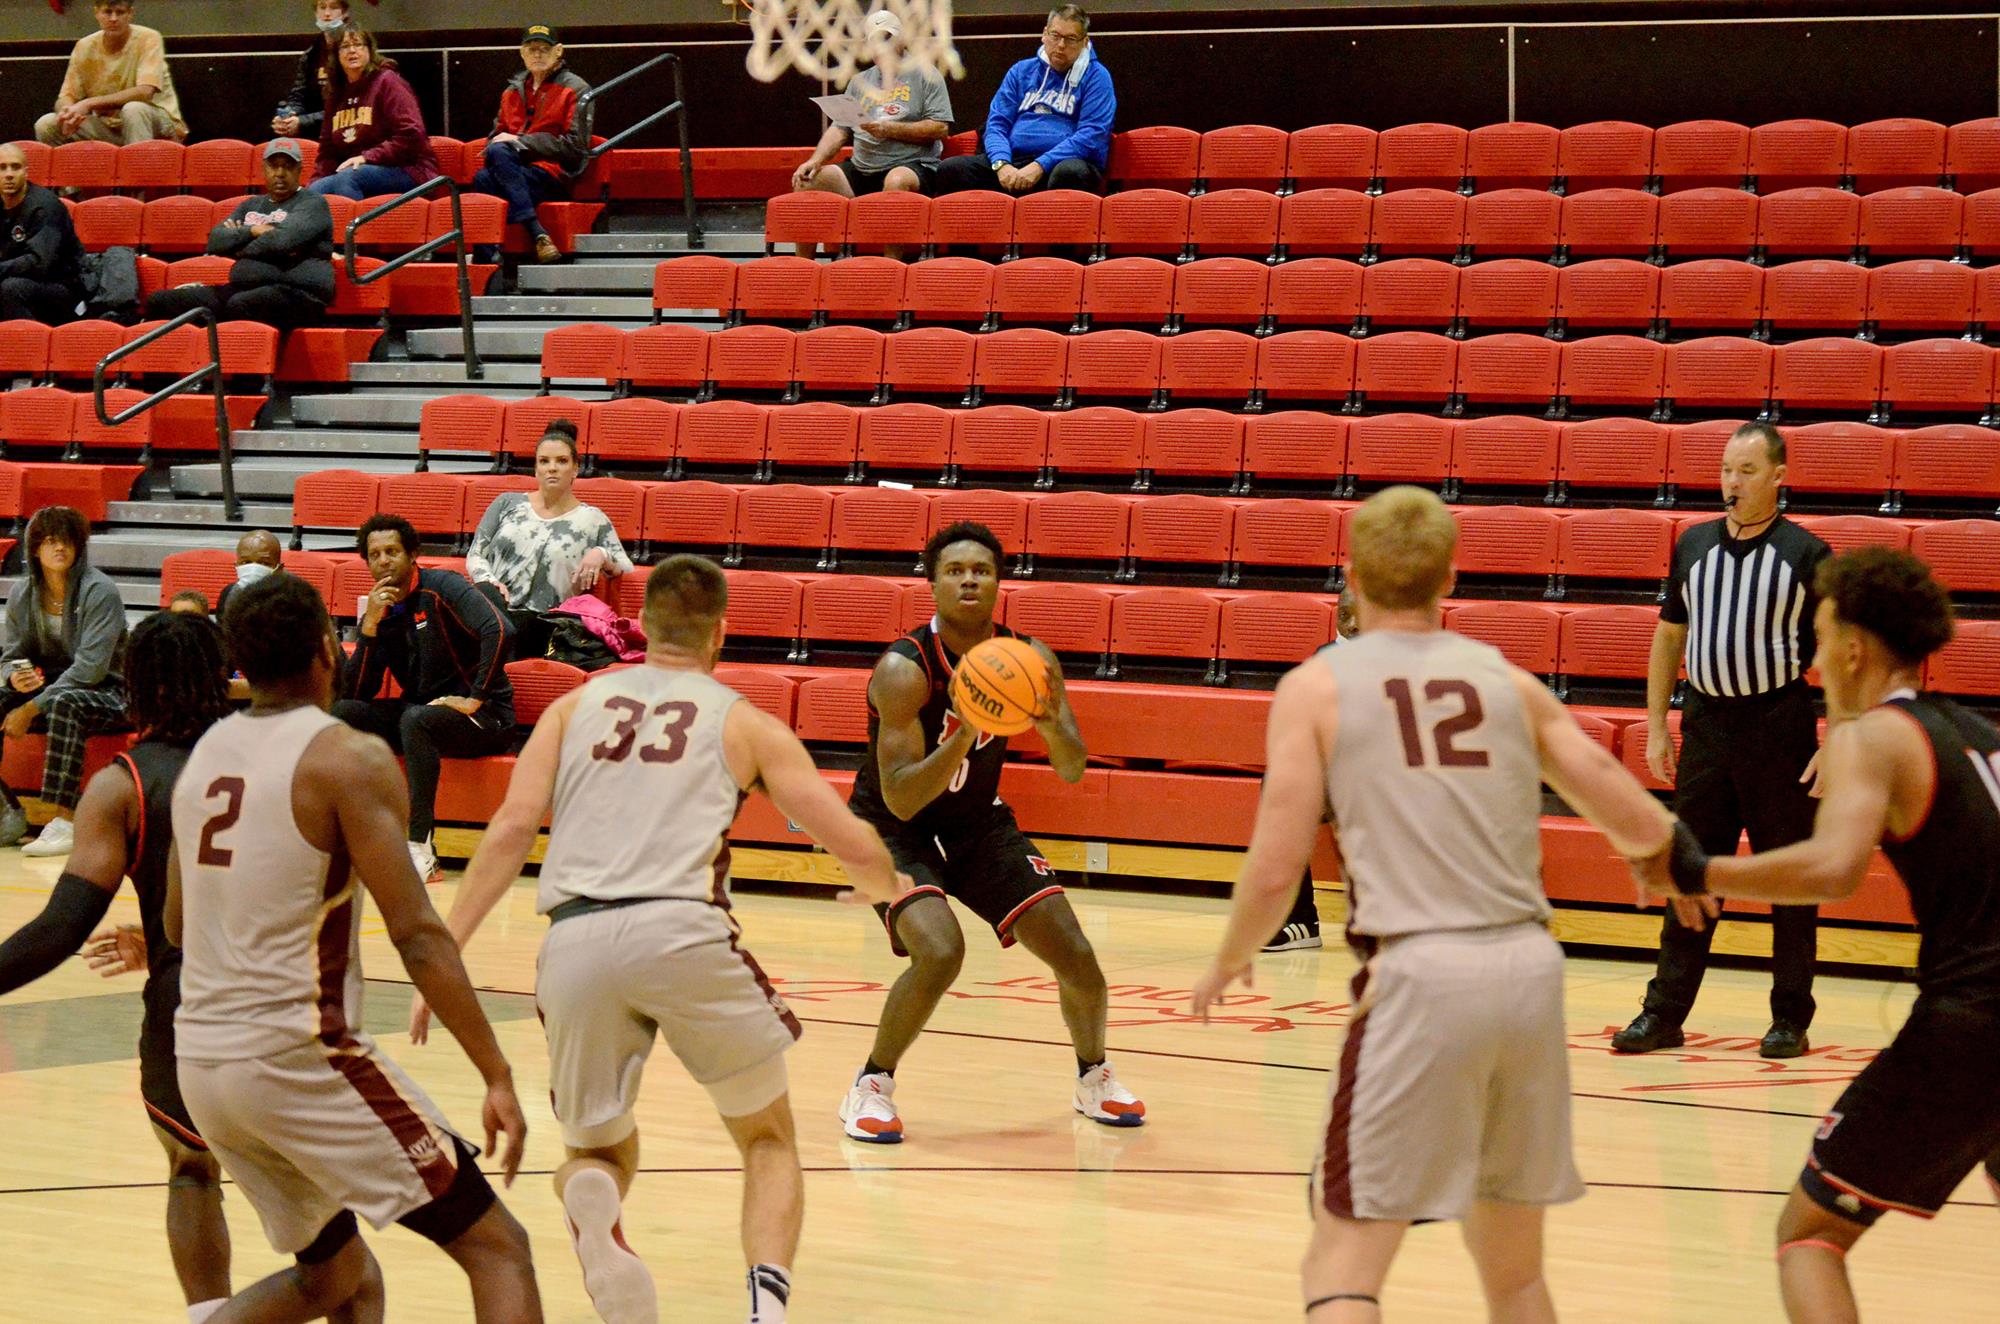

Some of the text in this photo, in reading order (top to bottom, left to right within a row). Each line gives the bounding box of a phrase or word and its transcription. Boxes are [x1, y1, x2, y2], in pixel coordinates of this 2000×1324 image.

[592, 695, 698, 763] 33
[960, 670, 1004, 719] Wilson
[1384, 678, 1490, 767] 12
[197, 775, 246, 868] 2
